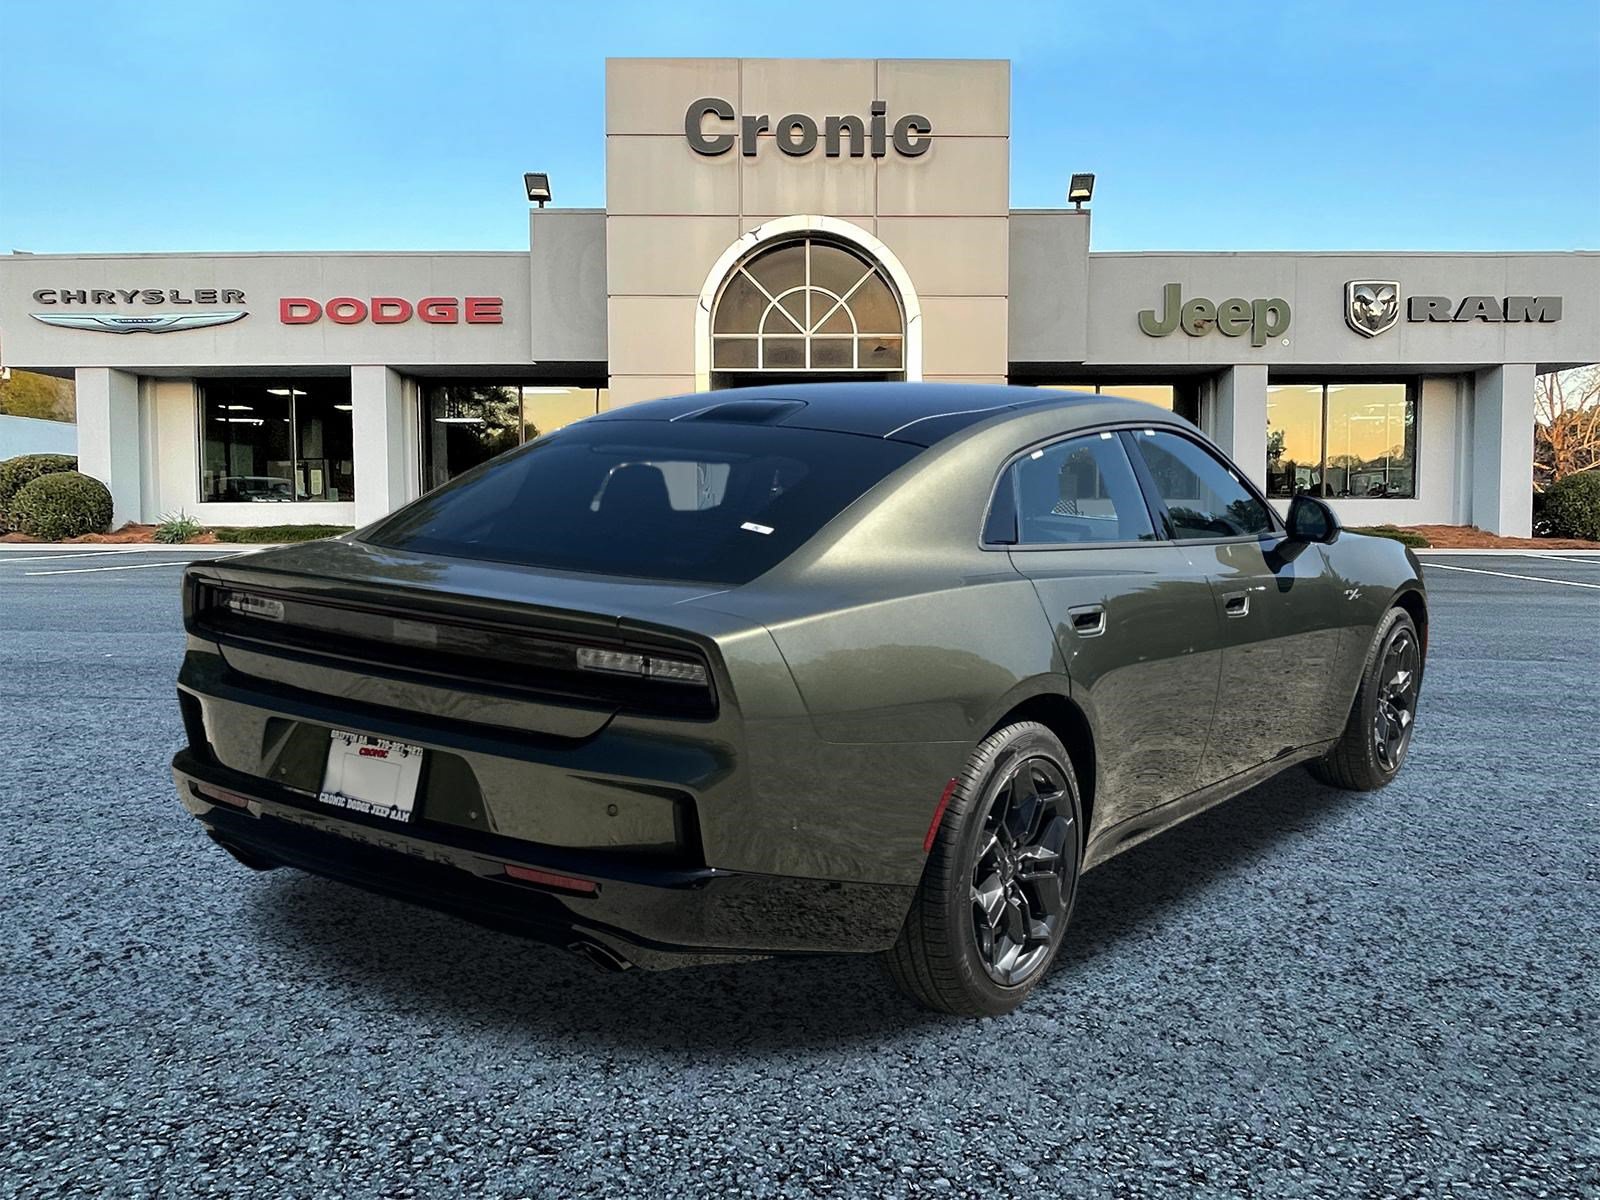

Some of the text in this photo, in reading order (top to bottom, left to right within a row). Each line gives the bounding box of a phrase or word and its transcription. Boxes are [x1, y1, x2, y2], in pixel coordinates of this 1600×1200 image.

[685, 97, 932, 158] Cronic
[32, 288, 247, 305] CHRYSLER
[279, 296, 504, 325] DODGE
[1407, 296, 1563, 323] RAM
[1138, 283, 1291, 347] Jeep
[358, 747, 389, 759] CRONIC
[319, 792, 411, 823] CRONIC DODGE JEEP RAM
